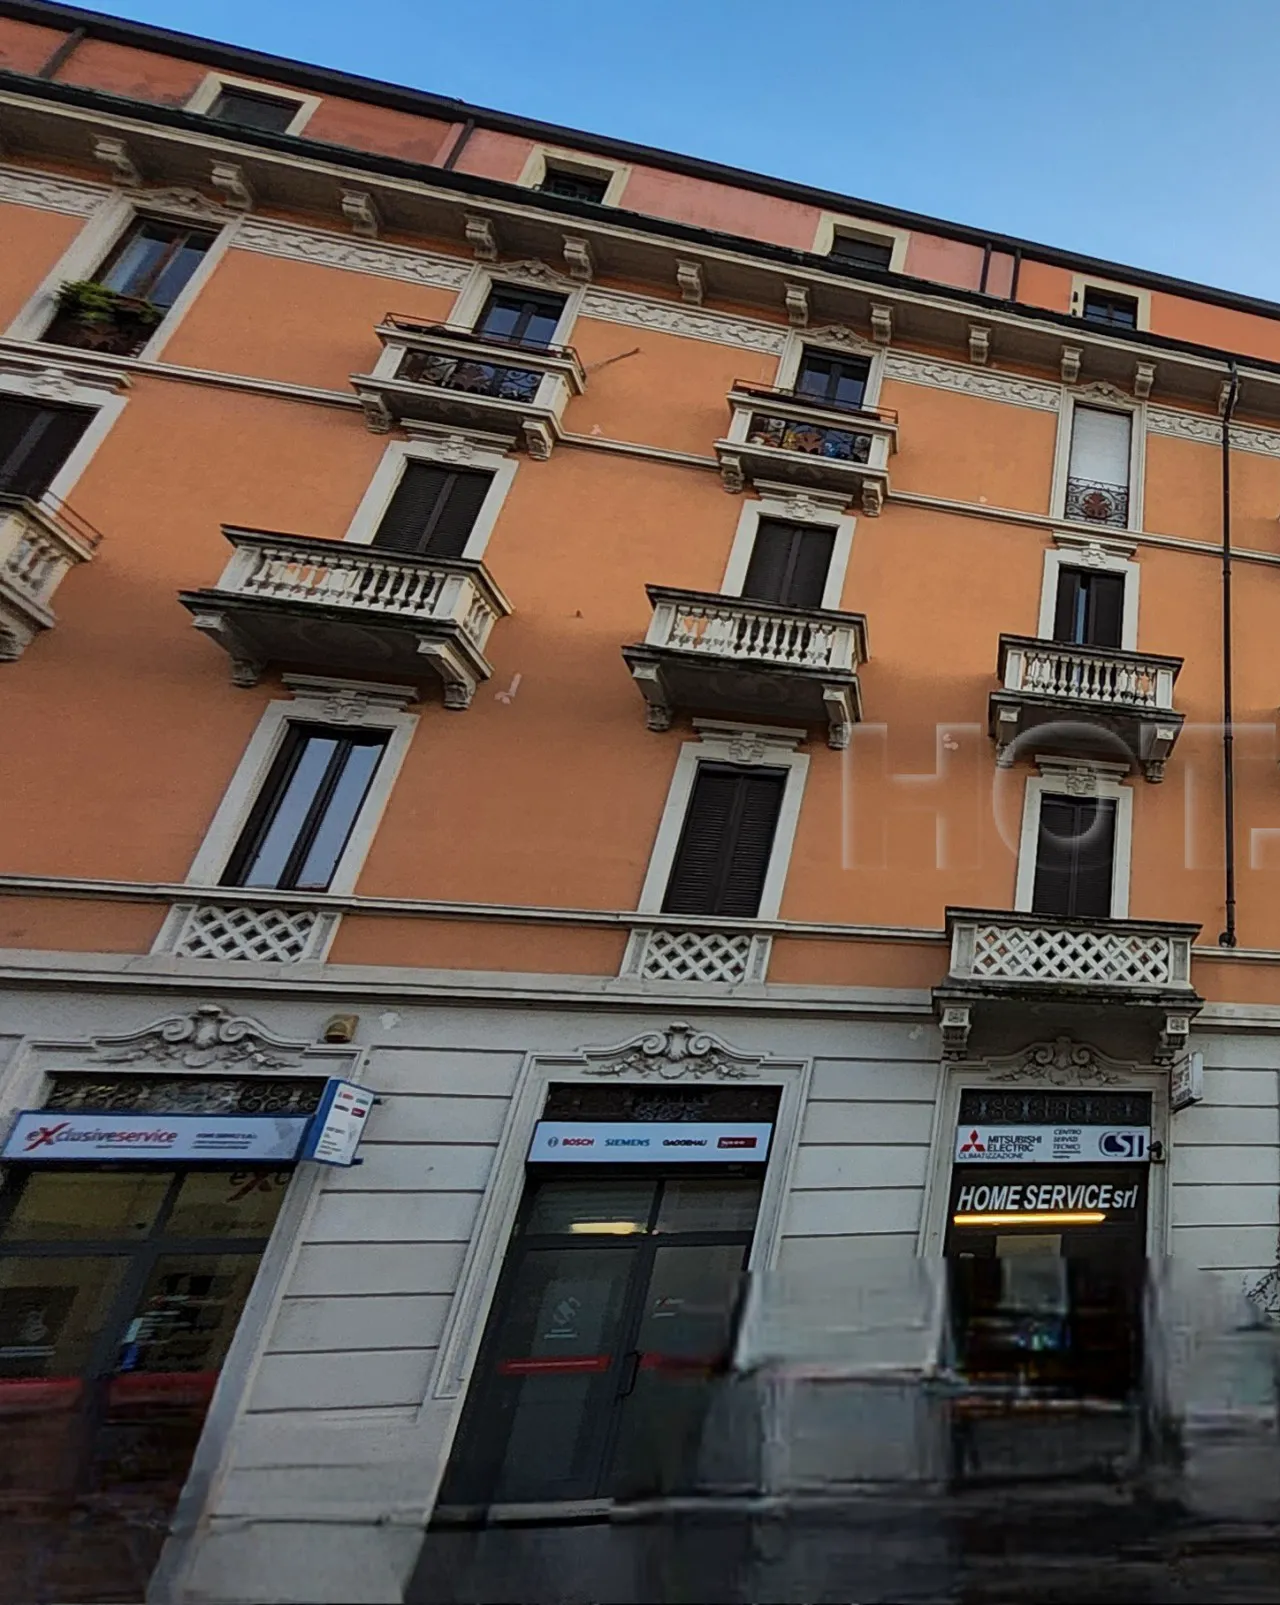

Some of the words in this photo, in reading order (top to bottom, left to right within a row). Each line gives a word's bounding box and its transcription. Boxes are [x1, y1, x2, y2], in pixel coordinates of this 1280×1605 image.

[562, 1138, 595, 1147] BOSCH
[604, 1138, 650, 1147] SIEMENS
[987, 1135, 1042, 1144] MITSUBISHI
[987, 1143, 1034, 1152] ELECTRIC
[957, 1185, 1022, 1211] HOME
